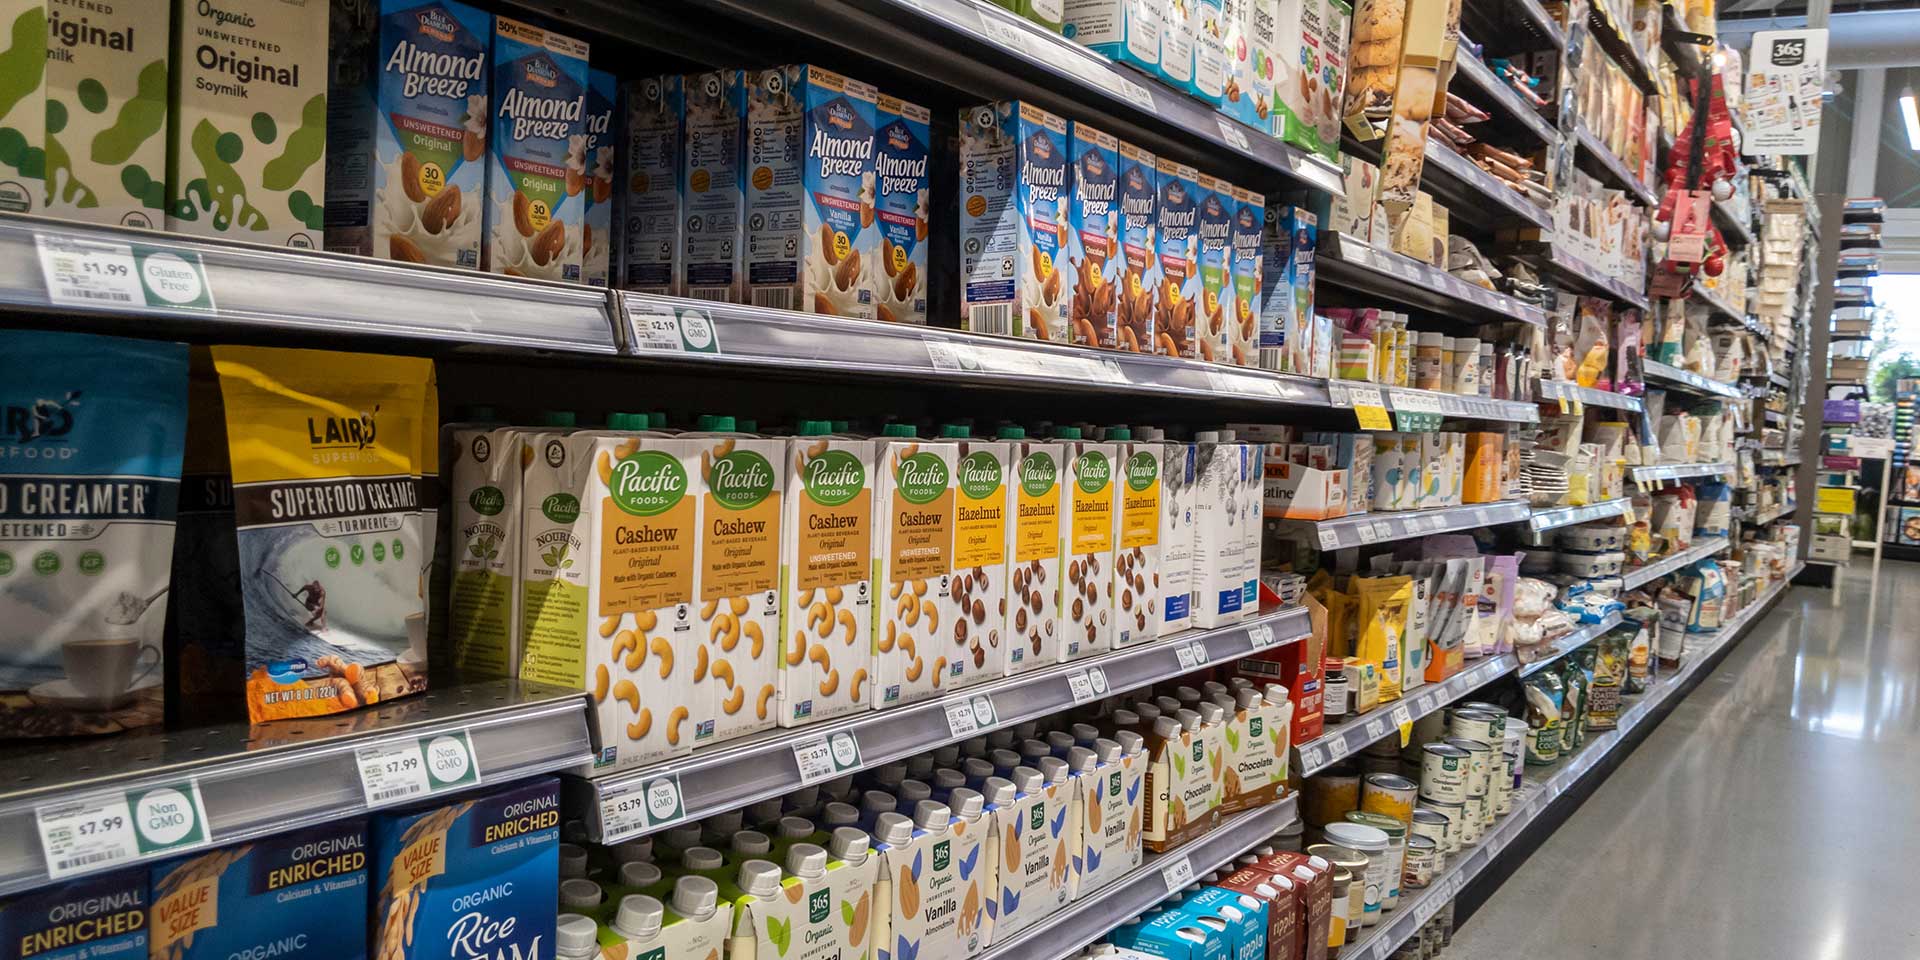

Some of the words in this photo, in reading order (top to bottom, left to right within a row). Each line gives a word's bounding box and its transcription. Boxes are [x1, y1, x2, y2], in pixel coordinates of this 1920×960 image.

[197, 0, 256, 28] Organic
[498, 21, 518, 35] 50%
[197, 27, 281, 53] UNSWEETENED
[1773, 43, 1804, 58] 365
[196, 44, 299, 87] Original
[386, 41, 486, 81] Almond
[196, 77, 248, 99] Soymilk
[404, 74, 469, 99] Breeze
[499, 88, 584, 121] Almond
[403, 120, 462, 140] UNSWEETENED
[514, 118, 569, 140] Breeze
[413, 135, 452, 152] Original
[810, 129, 874, 159] Almond
[424, 167, 439, 179] 30
[514, 160, 565, 178] UNSWEETENED
[821, 156, 862, 178] Breeze
[875, 151, 928, 177] Almond
[1021, 161, 1065, 186] Almond
[522, 177, 556, 193] Original
[882, 176, 918, 196] Breeze
[1029, 184, 1058, 204] Breeze
[1076, 176, 1116, 201] Almond
[533, 205, 545, 215] 30
[821, 196, 860, 211] UNSWEETENED
[1082, 200, 1108, 218] Breeze
[1120, 192, 1154, 215] Almond
[829, 209, 852, 221] Vanilla
[882, 212, 916, 226] UNSWEETENED
[1125, 213, 1148, 232] Breeze
[1158, 206, 1196, 228] Almond
[889, 225, 909, 237] Vanilla
[1163, 226, 1189, 243] Breeze
[1199, 219, 1231, 239] Almond
[836, 236, 846, 245] 30
[1203, 238, 1225, 255] Breeze
[1232, 230, 1262, 249] Almond
[895, 249, 904, 258] 30
[1236, 248, 1256, 264] Breeze
[83, 261, 128, 277] $1.99
[149, 265, 193, 281] Gluten
[160, 277, 190, 292] Free
[651, 320, 675, 331] $2.19
[688, 319, 703, 329] Non
[688, 328, 708, 339] GMO
[308, 416, 377, 445] LAIRD
[715, 459, 768, 492] Pacific
[810, 458, 860, 488] Pacific
[901, 459, 945, 488] Pacific
[963, 458, 998, 485] Pacific
[1023, 458, 1053, 482] Pacific
[1079, 457, 1107, 480] Pacific
[1128, 457, 1155, 481] Pacific
[617, 460, 681, 496] Pacific
[22, 482, 145, 515] CREAMER
[270, 483, 367, 519] SUPERFOOD
[631, 496, 664, 505] FOODS
[726, 492, 754, 500] FOODS
[820, 489, 846, 497] FOODS
[910, 488, 932, 496] FOODS
[1264, 486, 1295, 499] atine
[545, 496, 580, 514] Pacific
[1019, 504, 1055, 517] Hazelnut
[1075, 500, 1109, 513] Hazelnut
[1125, 497, 1156, 510] Hazelnut
[809, 513, 858, 530] Cashew
[900, 511, 942, 527] Cashew
[958, 506, 1000, 521] Hazelnut
[0, 522, 67, 538] ETENED
[338, 517, 388, 534] TURMERIC
[463, 523, 506, 542] NOURISH
[713, 518, 766, 536] Cashew
[536, 531, 582, 551] NOURISH
[615, 525, 679, 545] Cashew
[819, 538, 846, 550] Original
[908, 534, 931, 546] Original
[613, 547, 648, 555] PLANT-BASED
[724, 546, 752, 559] Original
[809, 552, 857, 563] UNSWEETENED
[628, 555, 662, 569] Original
[637, 572, 655, 581] Organic
[656, 571, 677, 579] Cashews
[265, 692, 280, 704] NET
[282, 691, 294, 701] WT
[304, 689, 313, 698] OZ
[958, 708, 971, 718] $2.79
[436, 748, 457, 759] Non
[810, 748, 828, 760] $3.79
[837, 747, 851, 758] GMO
[386, 758, 418, 773] $7.99
[436, 757, 463, 771] GMO
[1238, 757, 1273, 773] Chocolate
[654, 789, 669, 798] Non
[1184, 782, 1212, 801] Chocolate
[150, 802, 178, 816] Non
[504, 794, 558, 819] ORIGINAL
[618, 798, 641, 812] $3.79
[654, 797, 673, 809] GMO
[149, 813, 184, 830] GMO
[1032, 805, 1044, 821] 365
[79, 816, 123, 836] $7.99
[485, 811, 559, 843] ENRICHED
[1105, 820, 1126, 838] Vanilla
[292, 834, 365, 862] ORIGINAL
[491, 842, 518, 855] Calcium
[526, 832, 551, 846] Vitamin
[553, 830, 559, 840] D
[1028, 833, 1046, 847] Organic
[403, 838, 440, 870] VALUE
[934, 845, 949, 863] 365
[1268, 852, 1293, 867] ripple
[268, 851, 366, 889] ENRICHED
[409, 857, 433, 884] SIZE
[1025, 855, 1050, 876] Vanilla
[930, 874, 953, 891] Organic
[1025, 872, 1049, 889] Almondmilk
[1228, 869, 1255, 886] ripple
[276, 886, 311, 904] Calcium
[323, 878, 357, 893] Vitamin
[358, 874, 366, 884] D
[452, 882, 513, 913] ORGANIC
[926, 887, 955, 903] UNSWEETENED
[1193, 888, 1221, 905] ripple
[49, 890, 143, 923] ORIGINAL
[160, 885, 210, 923] VALUE
[810, 891, 829, 913] 365
[925, 898, 957, 923] Vanilla
[1312, 896, 1331, 915] ripple
[168, 908, 201, 939] SIZE
[925, 917, 955, 937] Almondmilk
[1151, 909, 1182, 928] ripple
[1273, 912, 1296, 937] ripple
[21, 910, 145, 957] ENRICHED
[447, 911, 517, 958] Rice
[805, 924, 833, 944] Organic
[91, 938, 133, 955] Vitamin
[135, 935, 145, 947] D
[227, 934, 307, 960] ORGANIC
[1239, 934, 1264, 960] ripple
